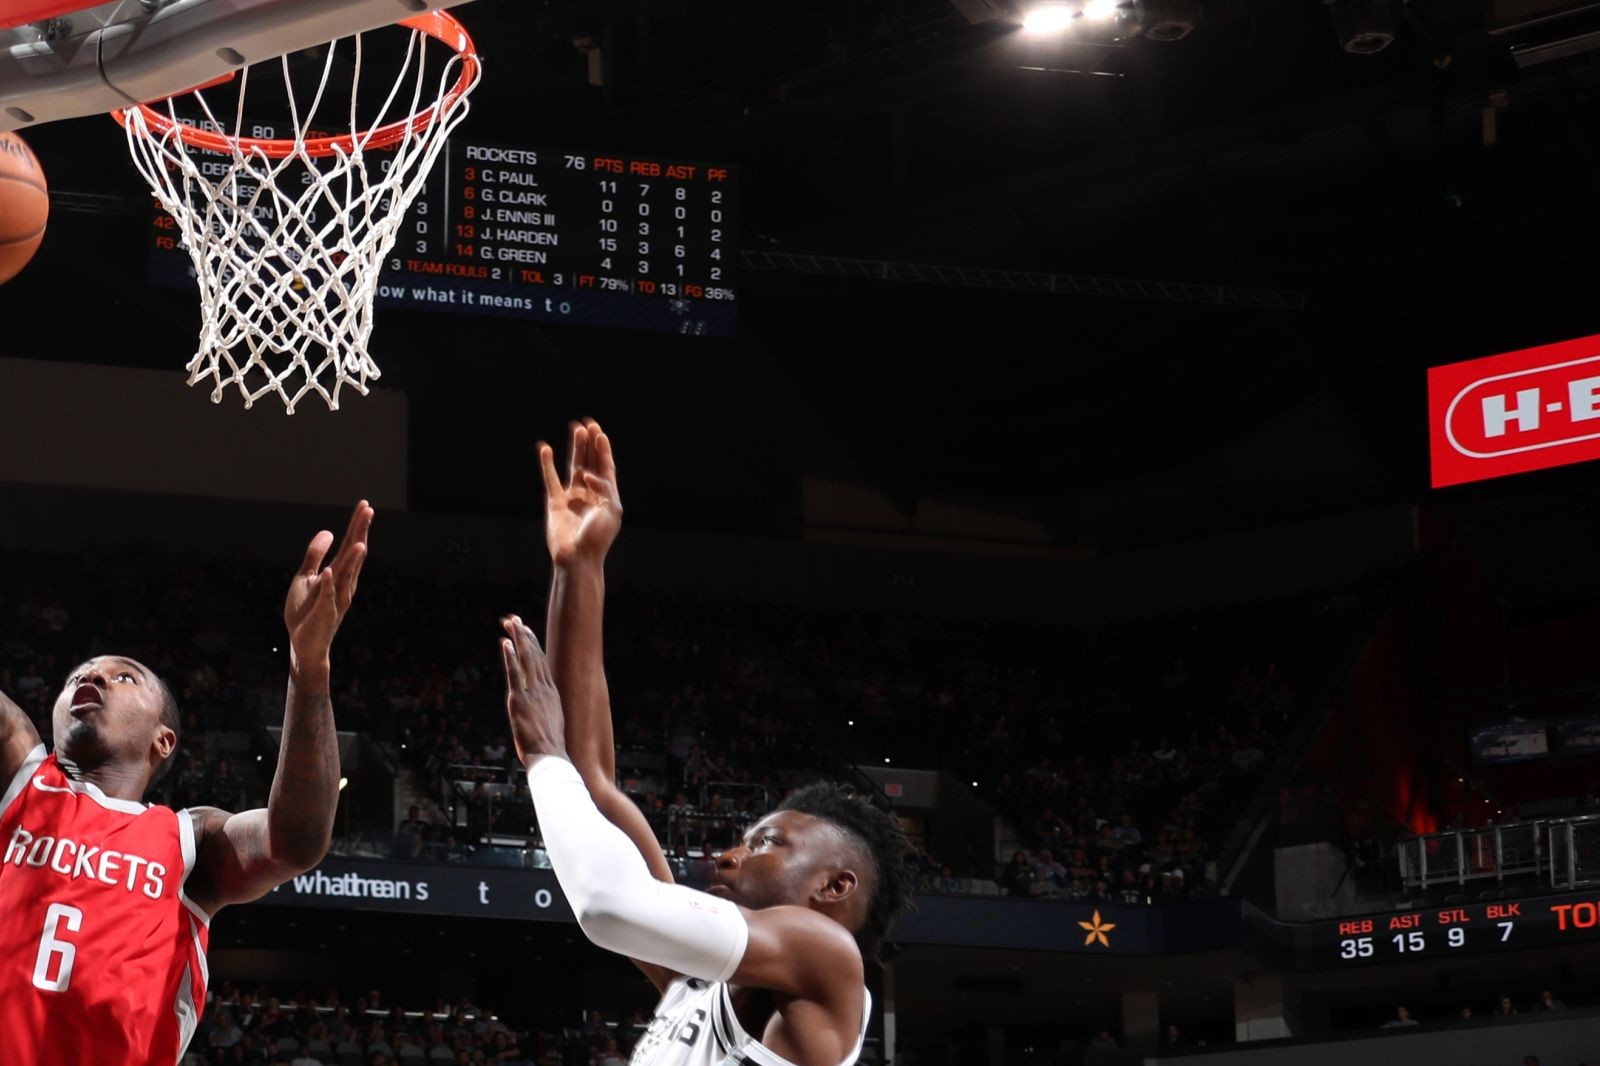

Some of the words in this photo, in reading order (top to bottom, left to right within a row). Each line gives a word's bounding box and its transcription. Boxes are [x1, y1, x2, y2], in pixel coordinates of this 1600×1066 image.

[252, 125, 275, 139] 80
[466, 146, 537, 165] ROCKETS
[564, 155, 585, 170] 76
[594, 158, 624, 174] PTS
[630, 161, 660, 177] REB
[666, 165, 696, 180] AST
[708, 169, 727, 182] PF
[464, 167, 475, 181] 3
[482, 169, 495, 183] C.
[499, 173, 538, 187] PAUL
[599, 181, 617, 194] 11
[639, 184, 650, 197] 7
[675, 187, 686, 201] 8
[711, 190, 722, 204] 2
[416, 202, 428, 214] 3
[464, 187, 475, 200] 6
[481, 189, 496, 202] G.
[499, 190, 548, 207] CLARK
[602, 200, 613, 213] 0
[638, 203, 650, 216] 0
[675, 207, 686, 219] 0
[711, 210, 722, 223] 0
[464, 206, 475, 219] 8
[481, 207, 495, 222] J.
[497, 210, 541, 225] ENNIS
[544, 213, 555, 226] III
[599, 219, 617, 233] 10
[638, 222, 649, 235] 3
[676, 226, 684, 238] 1
[711, 229, 722, 242] 2
[416, 241, 427, 253] 3
[456, 225, 474, 238] 13
[481, 227, 495, 241] J.
[497, 229, 558, 246] HARDEN
[599, 238, 617, 251] 15
[638, 242, 649, 254] 3
[674, 245, 685, 258] 6
[710, 248, 722, 260] 4
[406, 260, 444, 275] TEAM
[446, 263, 487, 278] FOULS
[491, 268, 501, 279] 2
[520, 270, 544, 284] TOL
[553, 273, 563, 285] 3
[579, 275, 595, 287] FT
[599, 277, 629, 292] 79%
[638, 280, 655, 293] TO
[660, 283, 676, 295] 13
[685, 285, 702, 298] FG
[704, 287, 735, 300] 36%
[456, 244, 473, 257] 14
[481, 246, 495, 260] G.
[498, 248, 546, 264] GREEN
[601, 257, 612, 270] 4
[638, 261, 649, 274] 3
[676, 264, 684, 276] 1
[710, 267, 721, 280] 2
[412, 286, 455, 303] what
[462, 289, 473, 304] it
[480, 293, 532, 309] means
[3, 824, 166, 899] ROCKETS
[1339, 920, 1373, 935] REB
[1389, 914, 1421, 930] AST
[1438, 909, 1470, 924] STL
[1486, 903, 1521, 919] BLK
[1551, 902, 1600, 931] TO
[32, 902, 83, 993] 6
[1340, 937, 1374, 959] 35
[1392, 931, 1425, 953] 15
[1448, 927, 1465, 947] 9
[1497, 922, 1514, 942] 7
